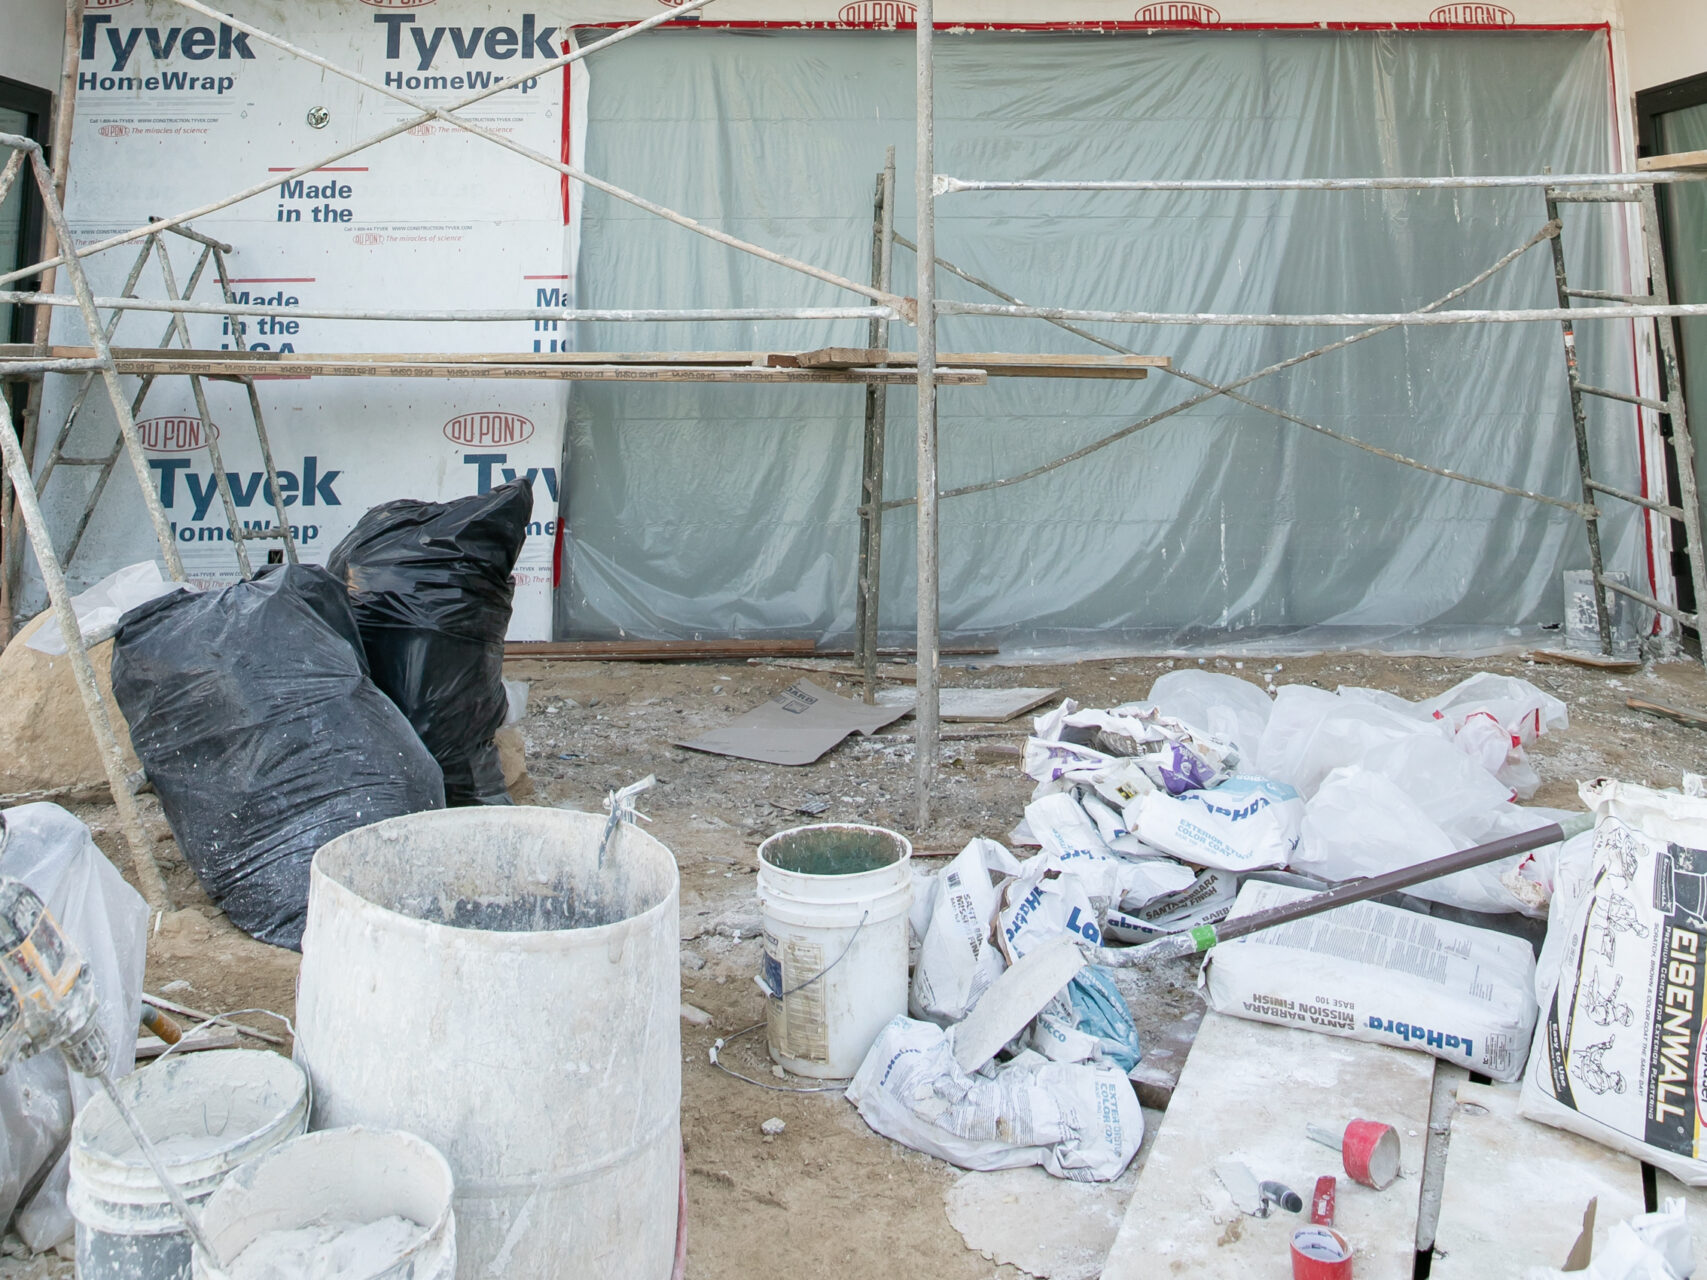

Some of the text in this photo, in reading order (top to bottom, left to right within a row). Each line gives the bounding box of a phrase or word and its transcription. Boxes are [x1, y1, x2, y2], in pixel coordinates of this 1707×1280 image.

[80, 14, 256, 71] Tyvek
[374, 13, 559, 71] Tyvek
[78, 72, 234, 94] HomeWrap
[280, 179, 353, 199] Made
[277, 203, 353, 223] in the
[257, 316, 299, 335] the
[149, 456, 342, 521] Tyvek
[158, 521, 319, 544] omeWap
[1177, 825, 1207, 845] COLOR
[1208, 840, 1232, 857] COAT
[1180, 818, 1223, 844] EXTERIOR
[1190, 886, 1218, 909] FINISH
[1648, 959, 1656, 986] BROWN
[1243, 1001, 1355, 1030] SANTA BARBARA
[1253, 993, 1354, 1023] MISSION FINISH
[1315, 995, 1354, 1010] BASE 100
[1368, 1016, 1473, 1057] LaHabra
[1647, 925, 1672, 1120] PREMIUM CEMENT FOR EXTERIOR PLASTERING
[1655, 927, 1698, 1124] EISENWALL
[1551, 1023, 1567, 1087] Easy to Use
[1639, 1057, 1647, 1079] SAME
